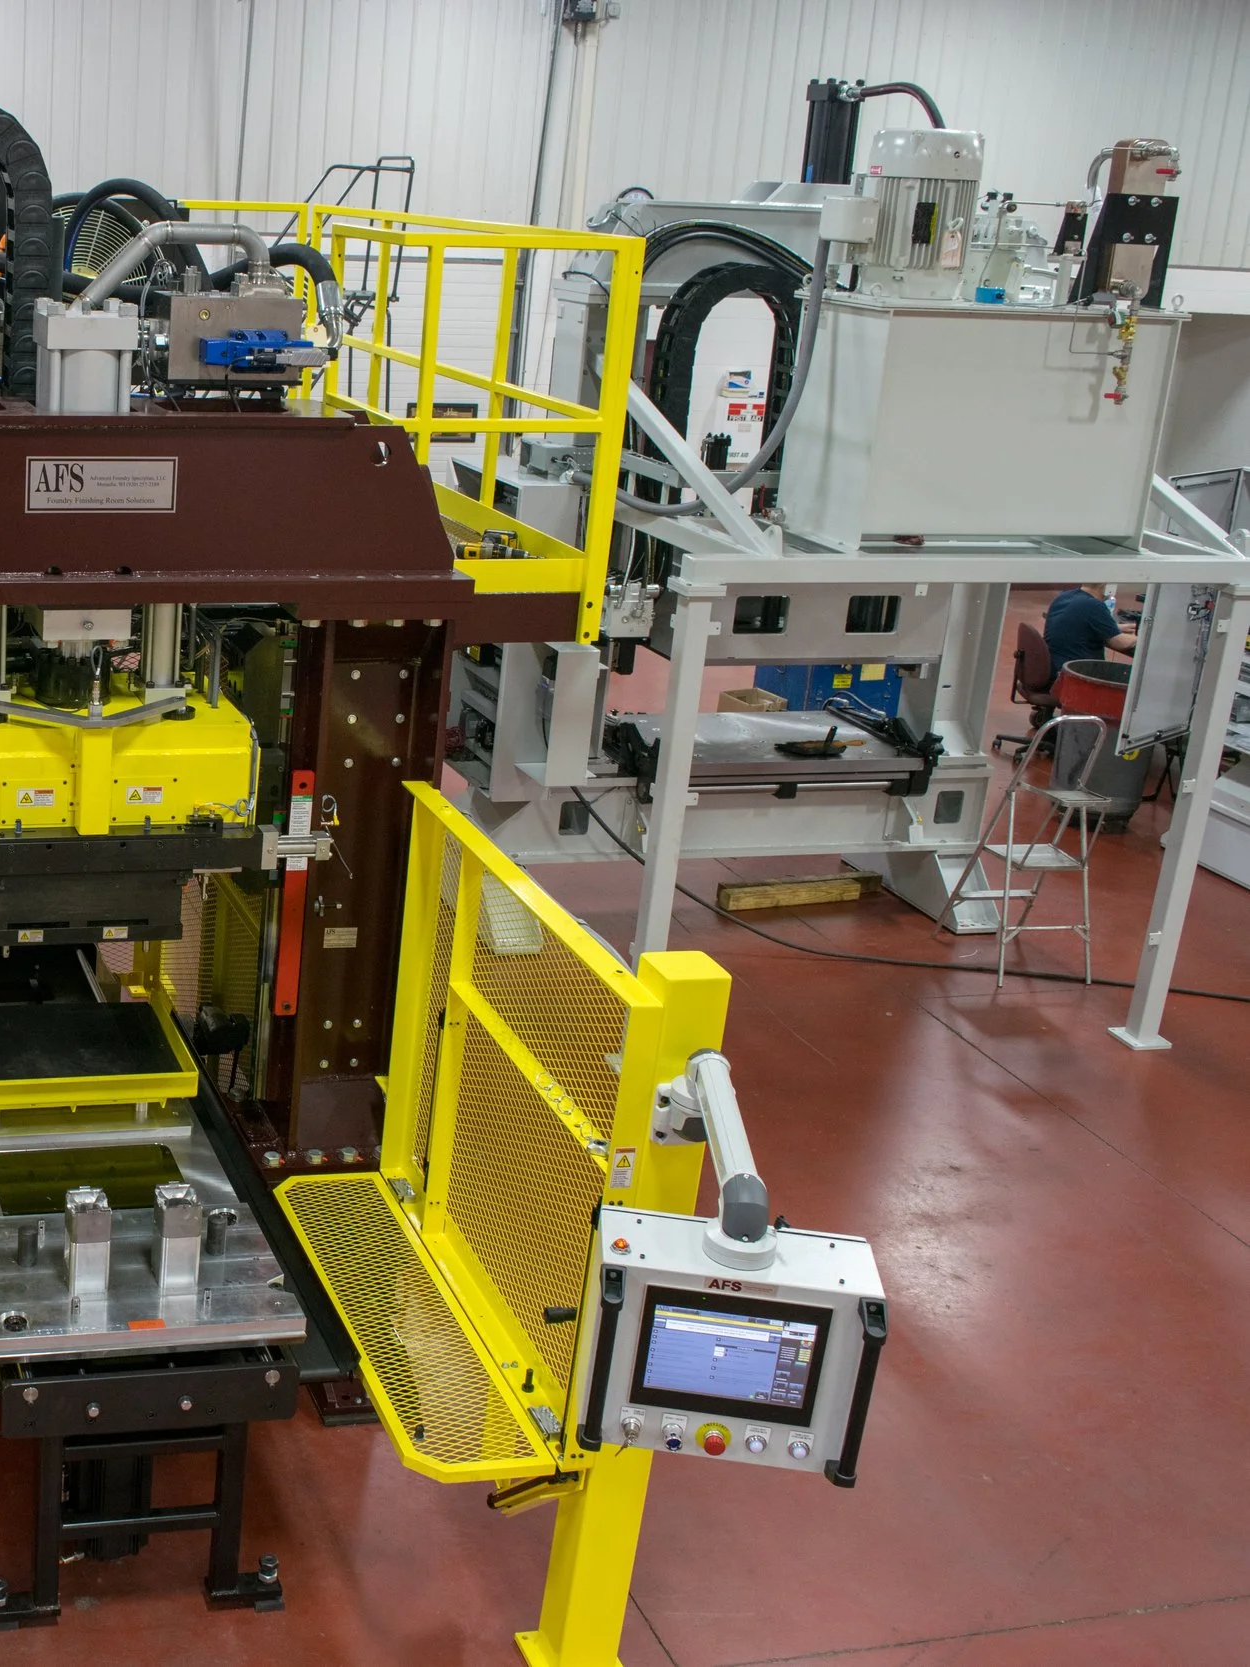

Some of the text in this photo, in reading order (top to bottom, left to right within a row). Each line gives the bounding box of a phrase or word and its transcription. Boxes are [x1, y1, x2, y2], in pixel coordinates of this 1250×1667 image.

[35, 463, 84, 492] AFS
[47, 497, 72, 505] Foundry
[75, 497, 104, 506] Finishing
[709, 1278, 743, 1292] AFS
